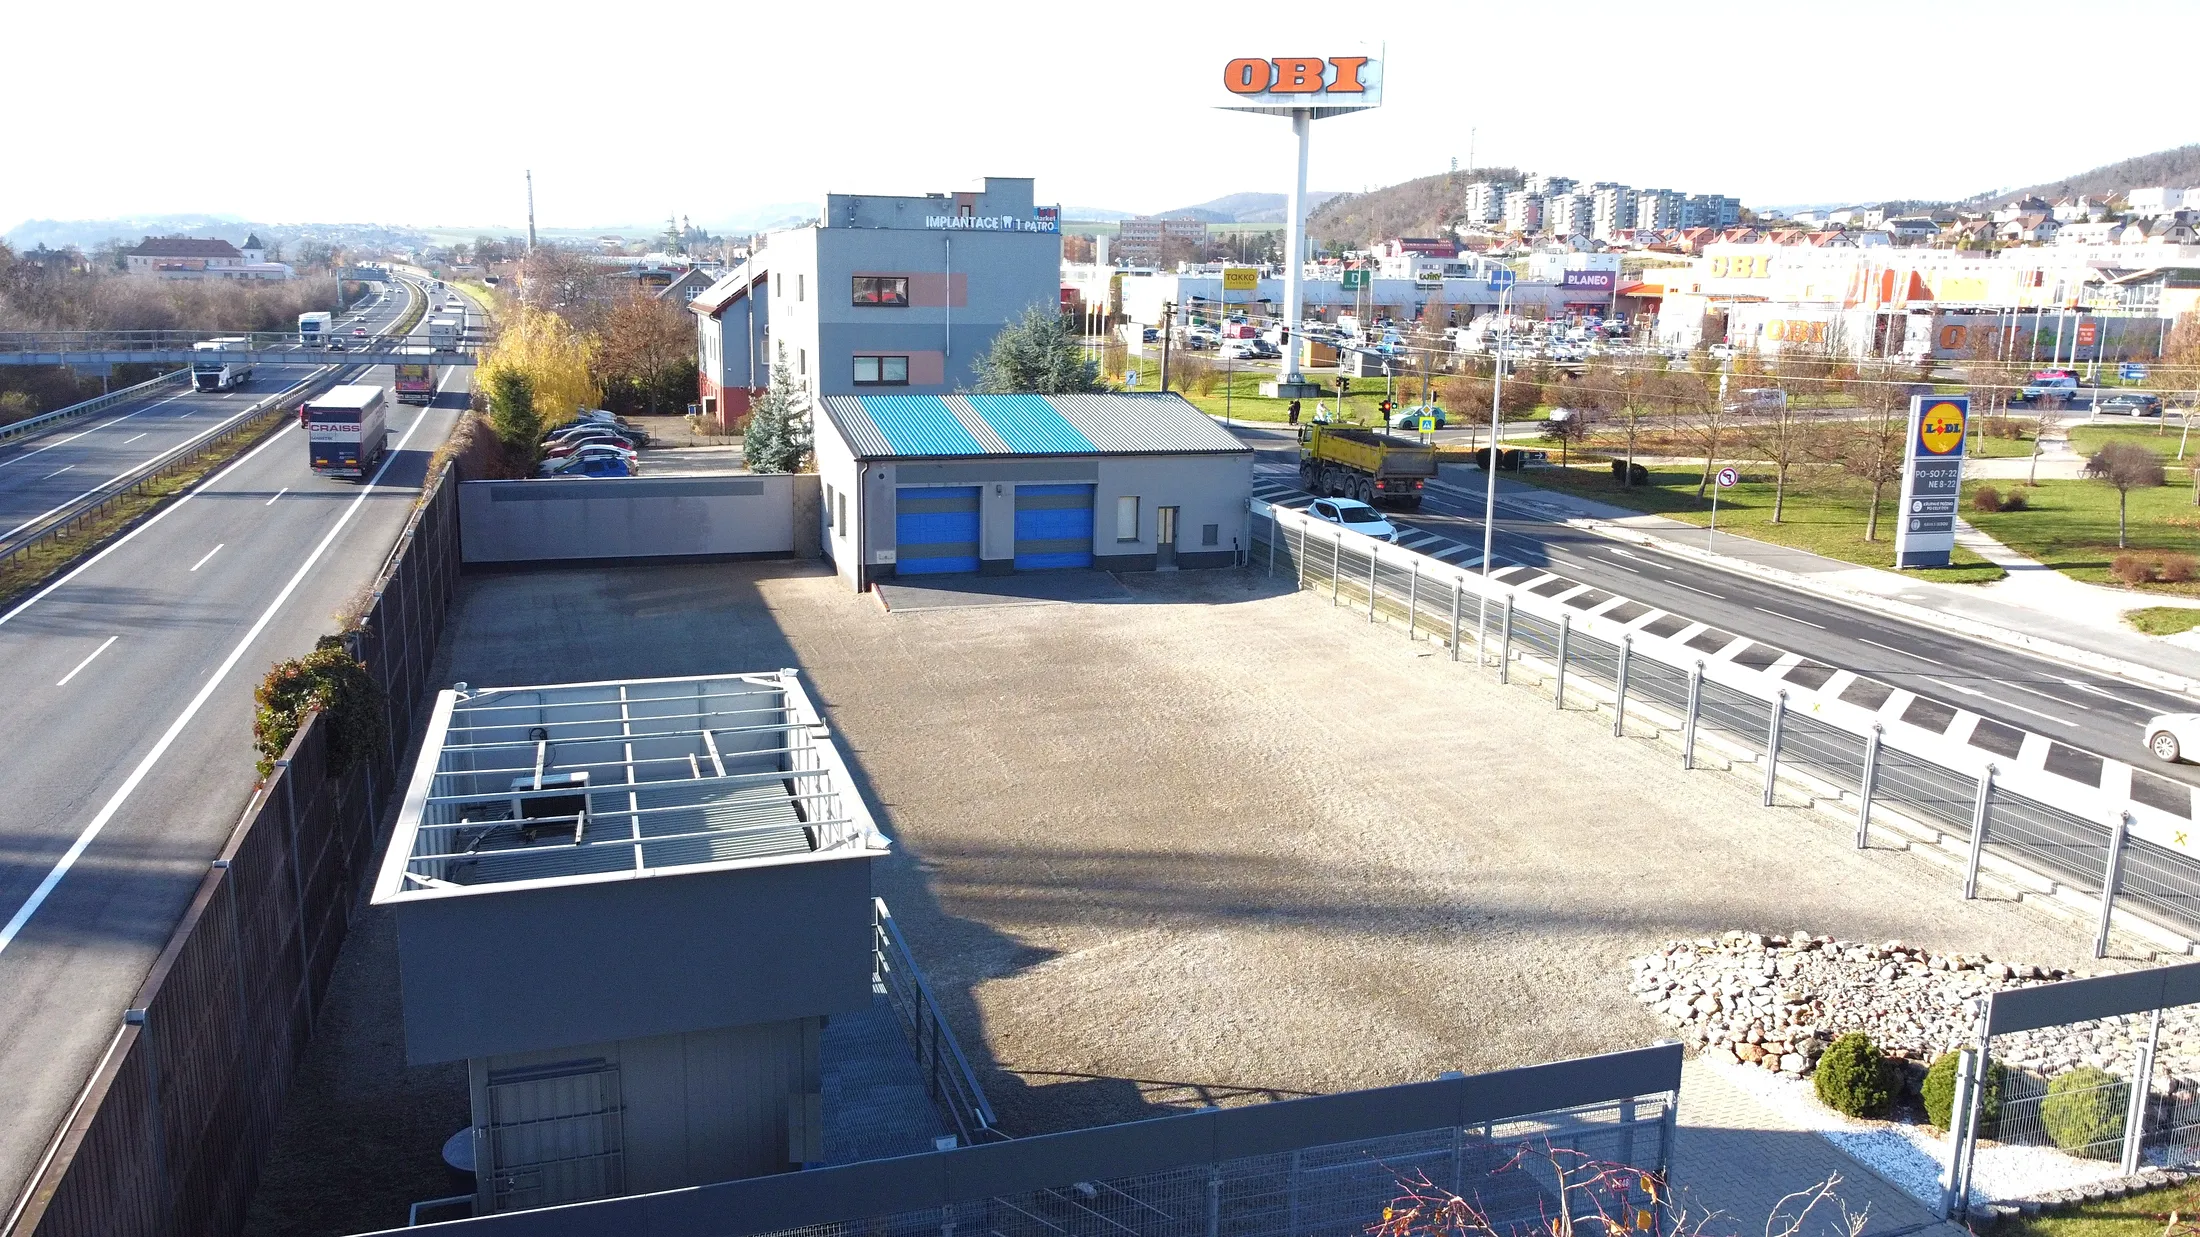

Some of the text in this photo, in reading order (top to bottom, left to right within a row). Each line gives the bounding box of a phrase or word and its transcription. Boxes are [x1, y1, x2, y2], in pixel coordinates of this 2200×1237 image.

[1224, 57, 1367, 94] OBI
[926, 215, 1055, 231] IMPLANTACE 1 PATRO
[1710, 256, 1771, 278] OBI
[1567, 275, 1608, 286] PLANEO
[1766, 320, 1829, 343] OBI
[311, 424, 360, 432] CRAISS
[1915, 469, 1957, 478] PO-SO 7-22
[1928, 480, 1956, 488] NE 8-22
